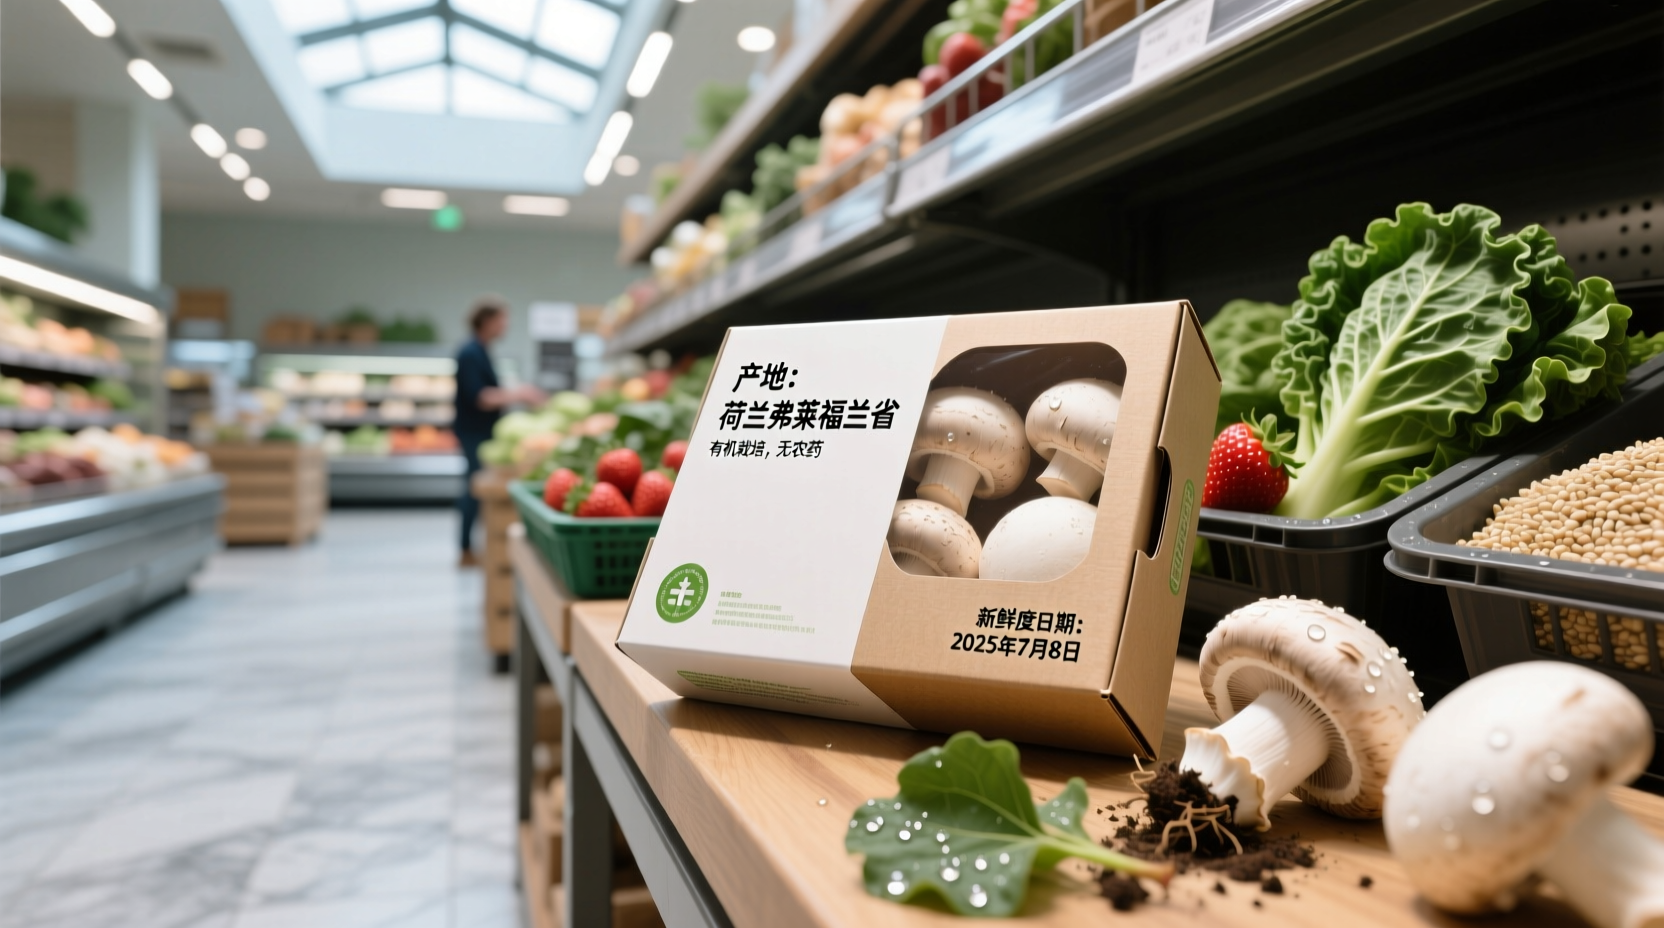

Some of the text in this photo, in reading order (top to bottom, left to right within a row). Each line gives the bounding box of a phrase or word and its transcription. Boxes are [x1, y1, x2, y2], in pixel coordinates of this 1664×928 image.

[719, 399, 900, 431] 荷兰弗莱福兰省
[709, 440, 824, 460] 有机栽培，无农药
[976, 607, 1083, 635] 新鲜度日期：
[950, 632, 1081, 663] 2025年7月8日
